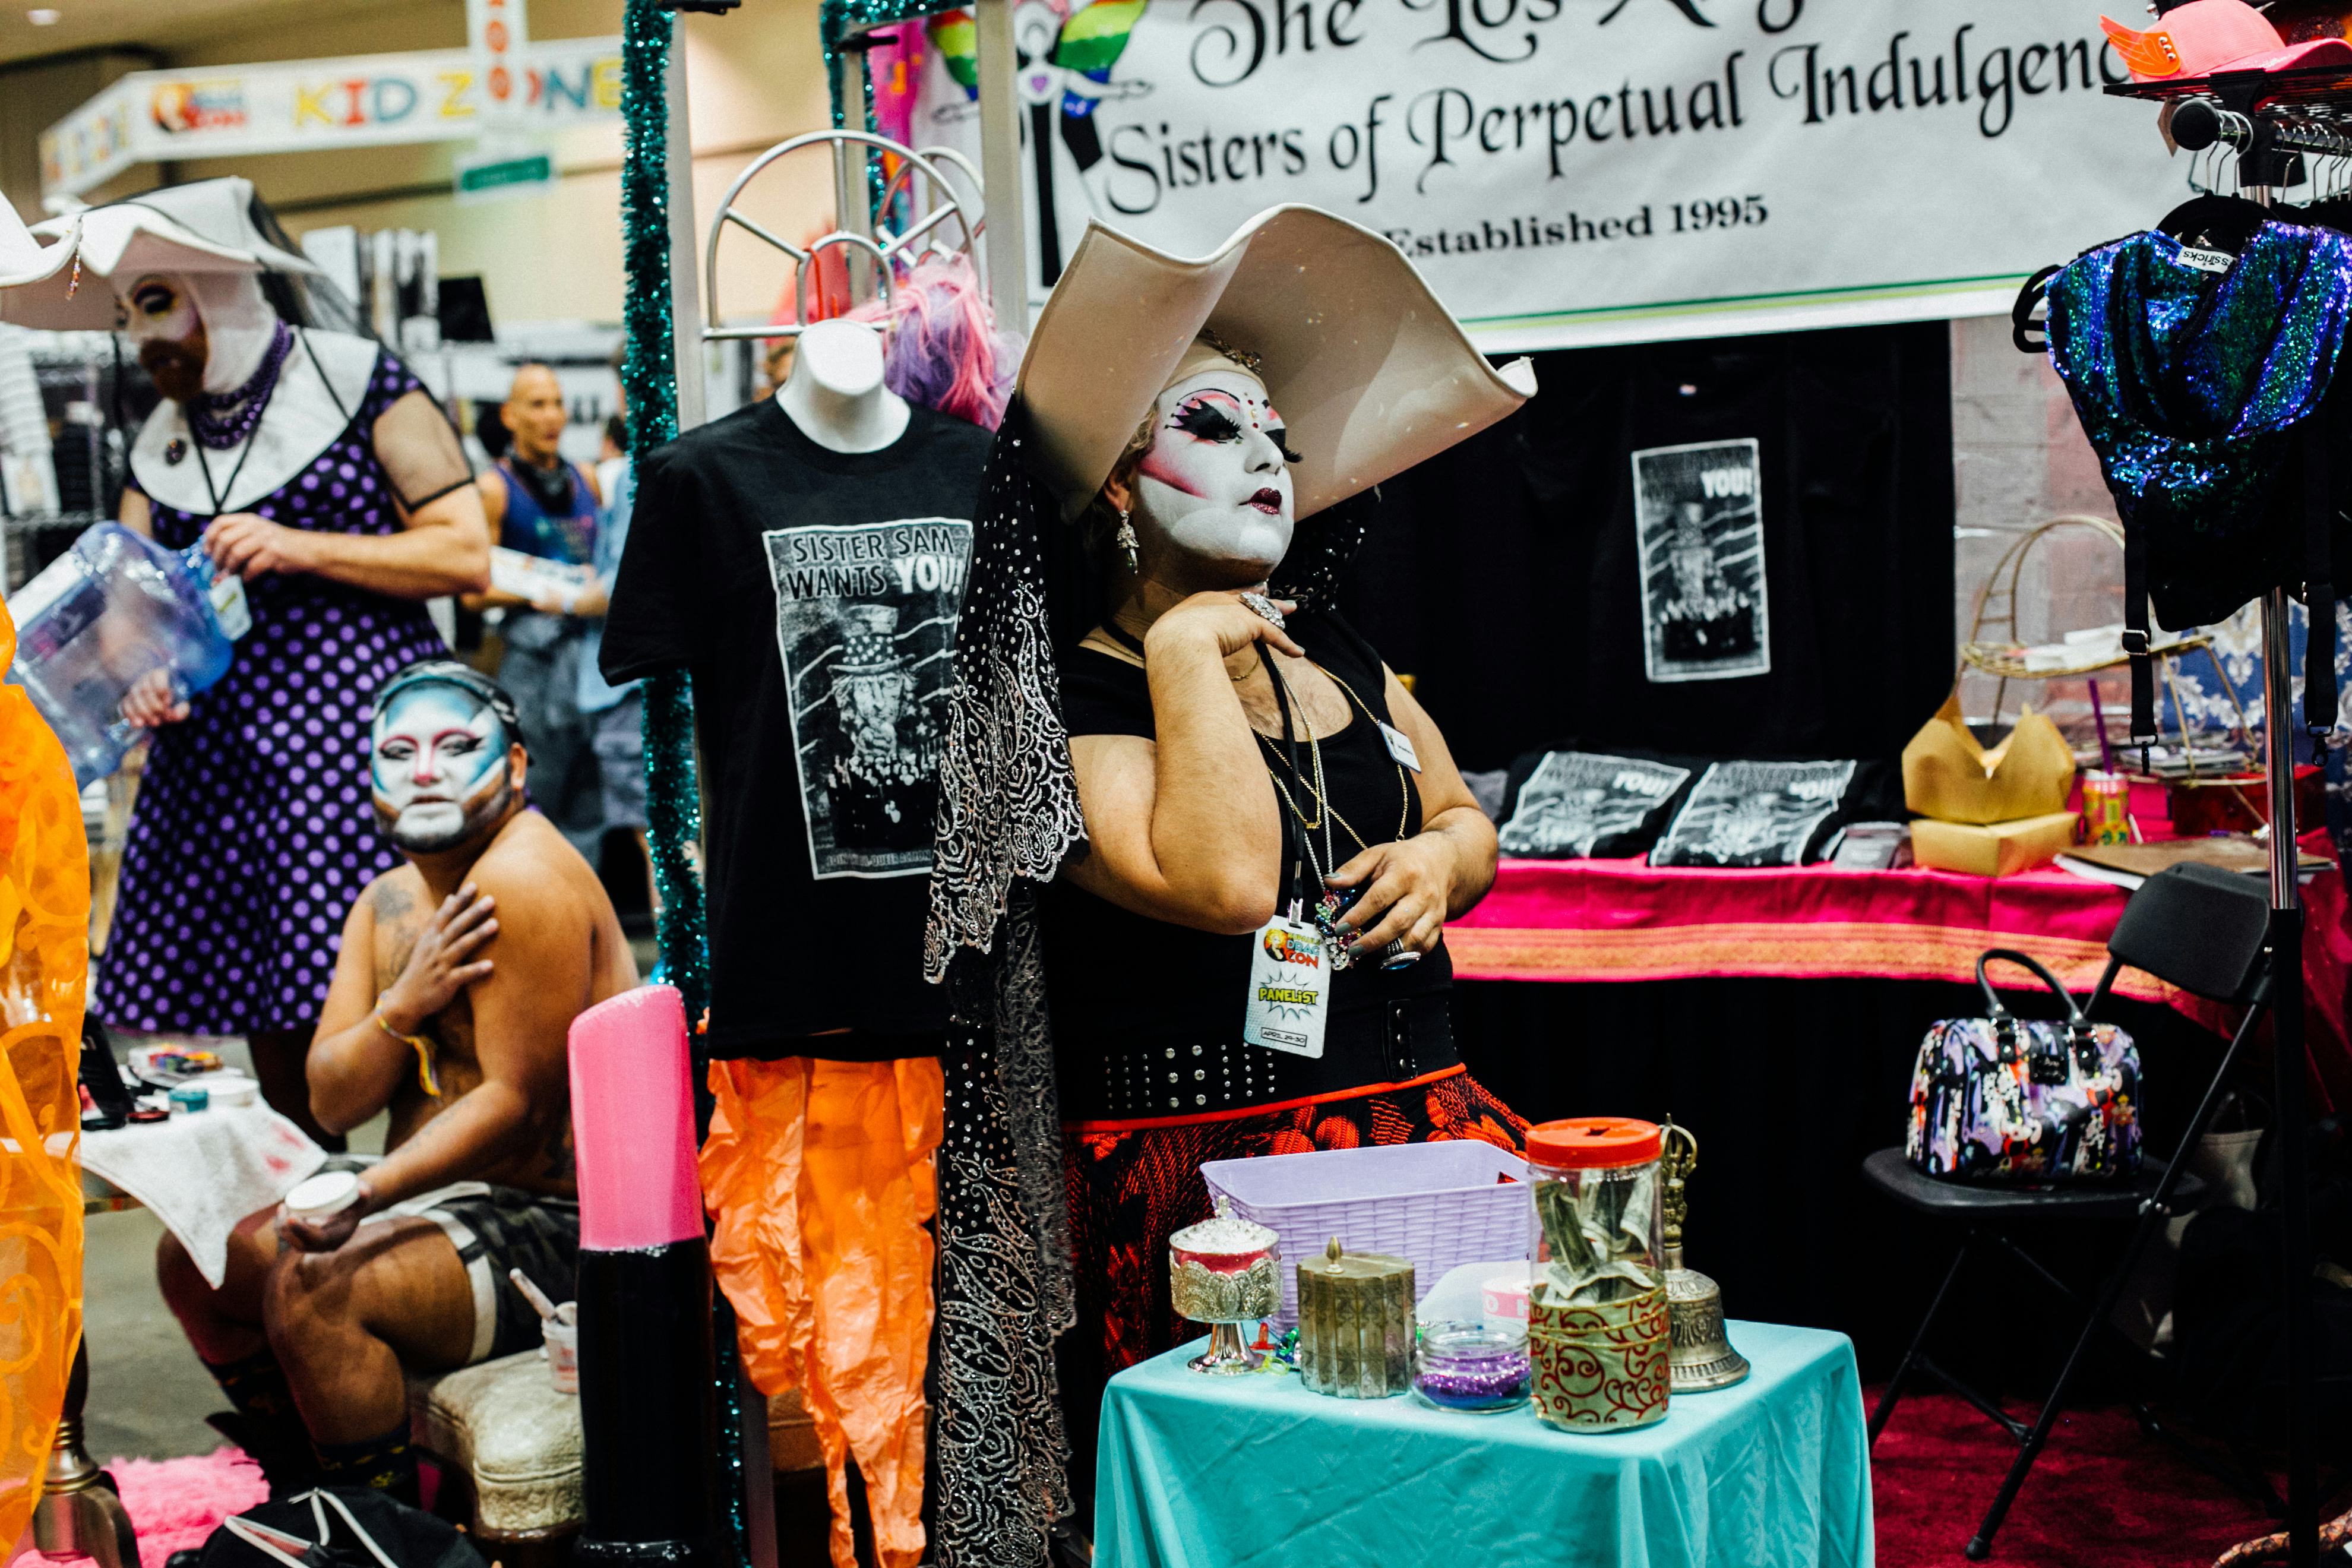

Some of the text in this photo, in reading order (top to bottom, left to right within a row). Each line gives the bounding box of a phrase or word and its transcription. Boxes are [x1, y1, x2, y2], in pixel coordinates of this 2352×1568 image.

[293, 76, 418, 127] KID
[438, 58, 624, 118] ZNE
[1106, 23, 2131, 215] Sisters of Perpetual Indulgenc
[1383, 195, 1769, 257] Established 1995
[792, 527, 955, 563] SISTER SAM
[787, 555, 965, 599] WANTS YOU!
[1286, 940, 1320, 956] DRAG
[1286, 949, 1319, 969] CON
